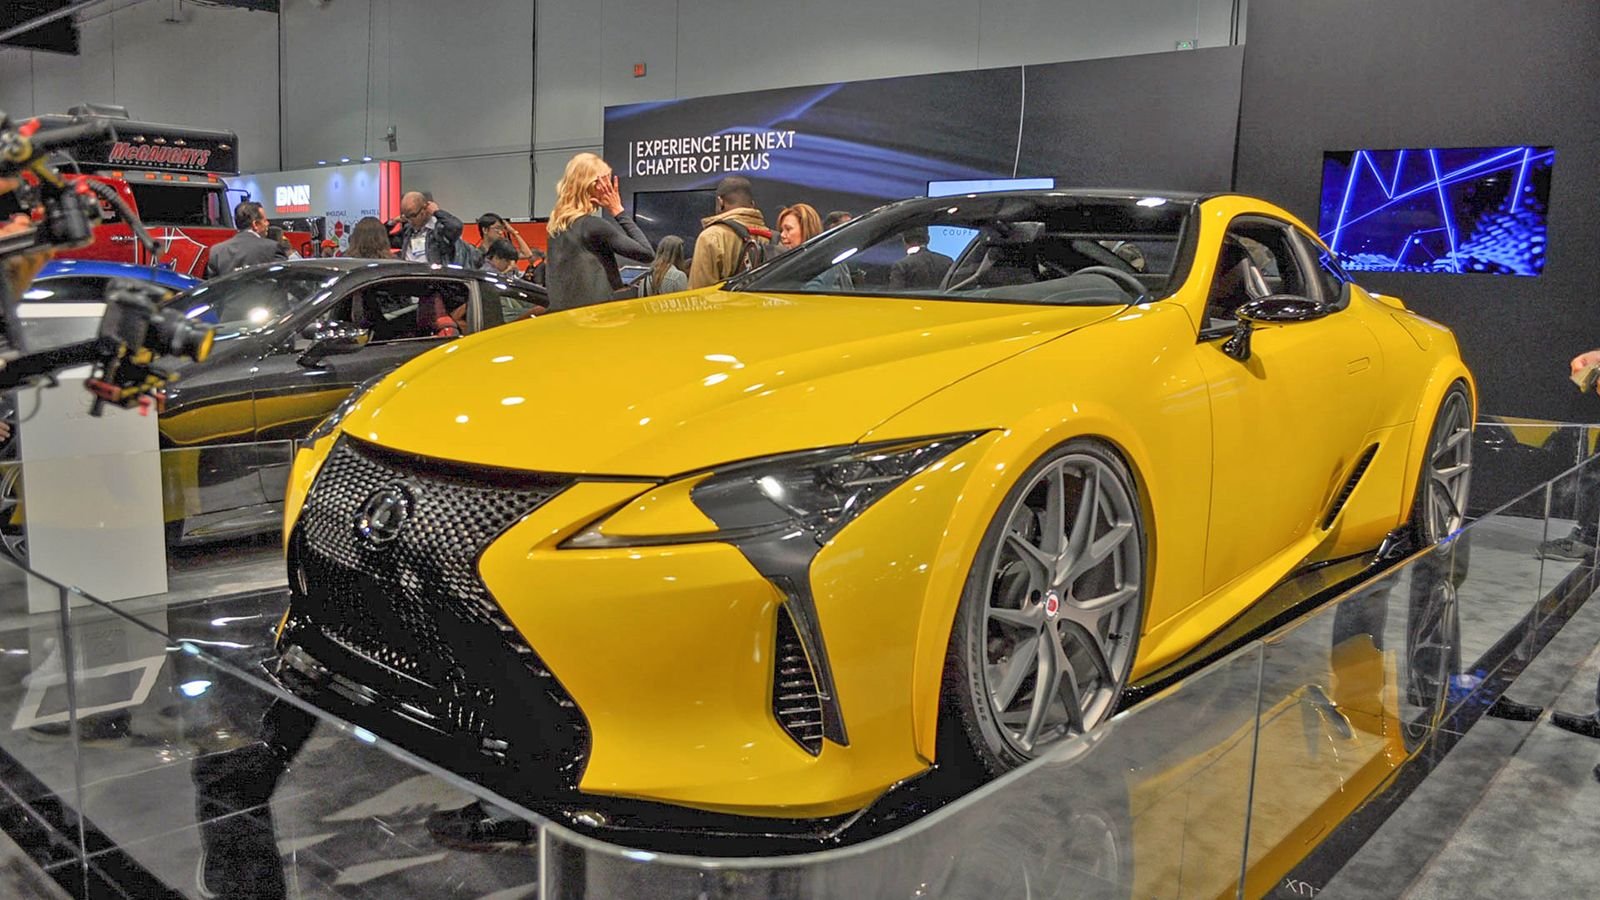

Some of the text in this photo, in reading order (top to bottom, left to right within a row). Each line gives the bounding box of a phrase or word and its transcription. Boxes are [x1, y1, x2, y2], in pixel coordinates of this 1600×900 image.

[636, 131, 796, 157] EXPERIENCE THE NEXT
[636, 153, 770, 176] CHAPTER OF LEXUS
